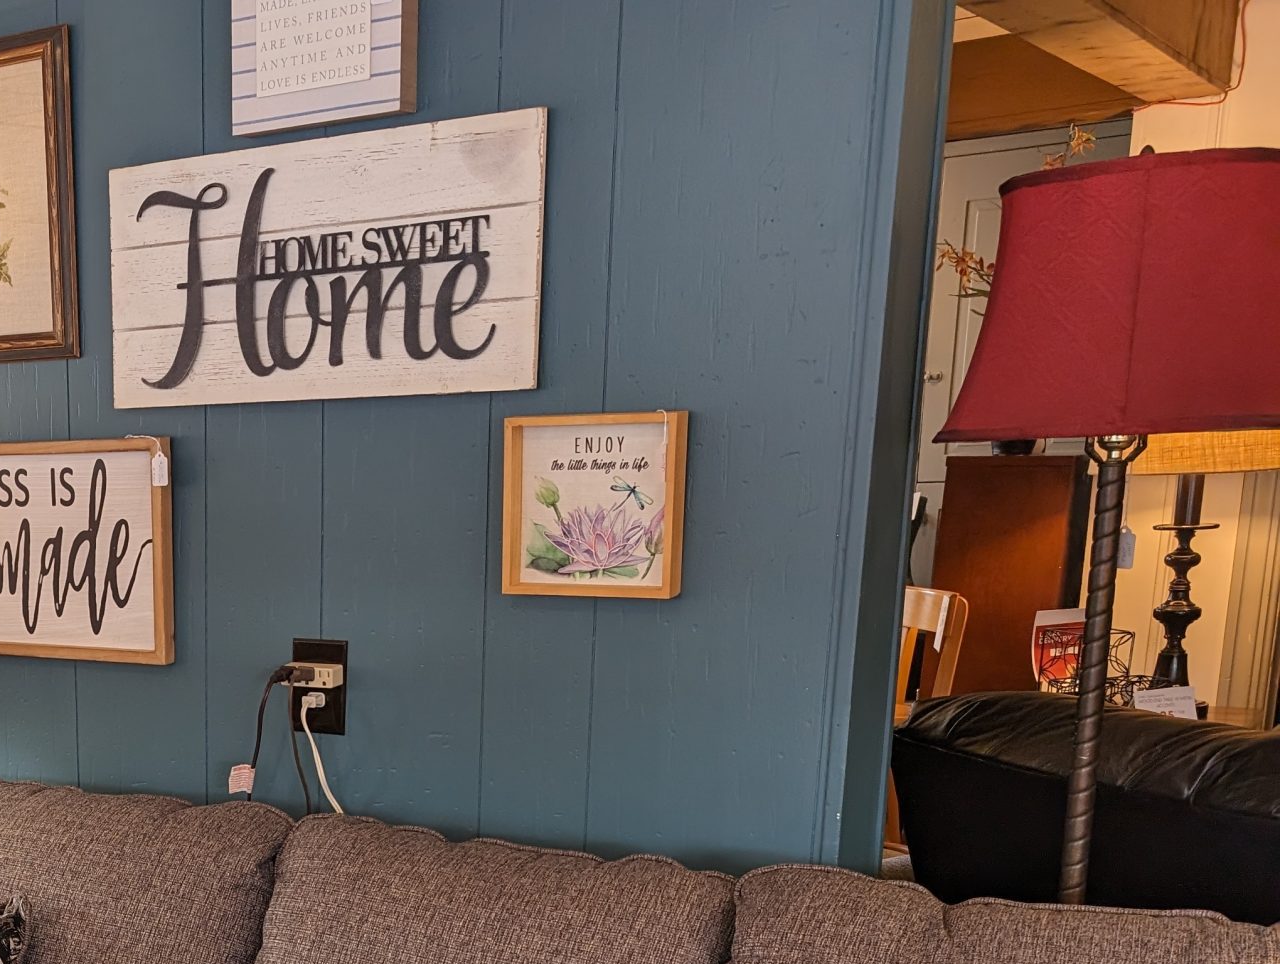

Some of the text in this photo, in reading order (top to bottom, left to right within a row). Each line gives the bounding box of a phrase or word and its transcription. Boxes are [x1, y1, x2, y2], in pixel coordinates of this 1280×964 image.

[260, 2, 366, 33] LIVES, FRIENDS
[260, 22, 366, 52] ARE WELCOME
[260, 43, 367, 72] ANYTIME AND
[260, 63, 366, 92] LOVE IS ENDLESS
[257, 214, 491, 277] HOME SWEET
[136, 167, 497, 389] Home
[574, 435, 625, 454] ENJOY
[550, 456, 650, 474] the little things in life
[49, 466, 76, 507] IS
